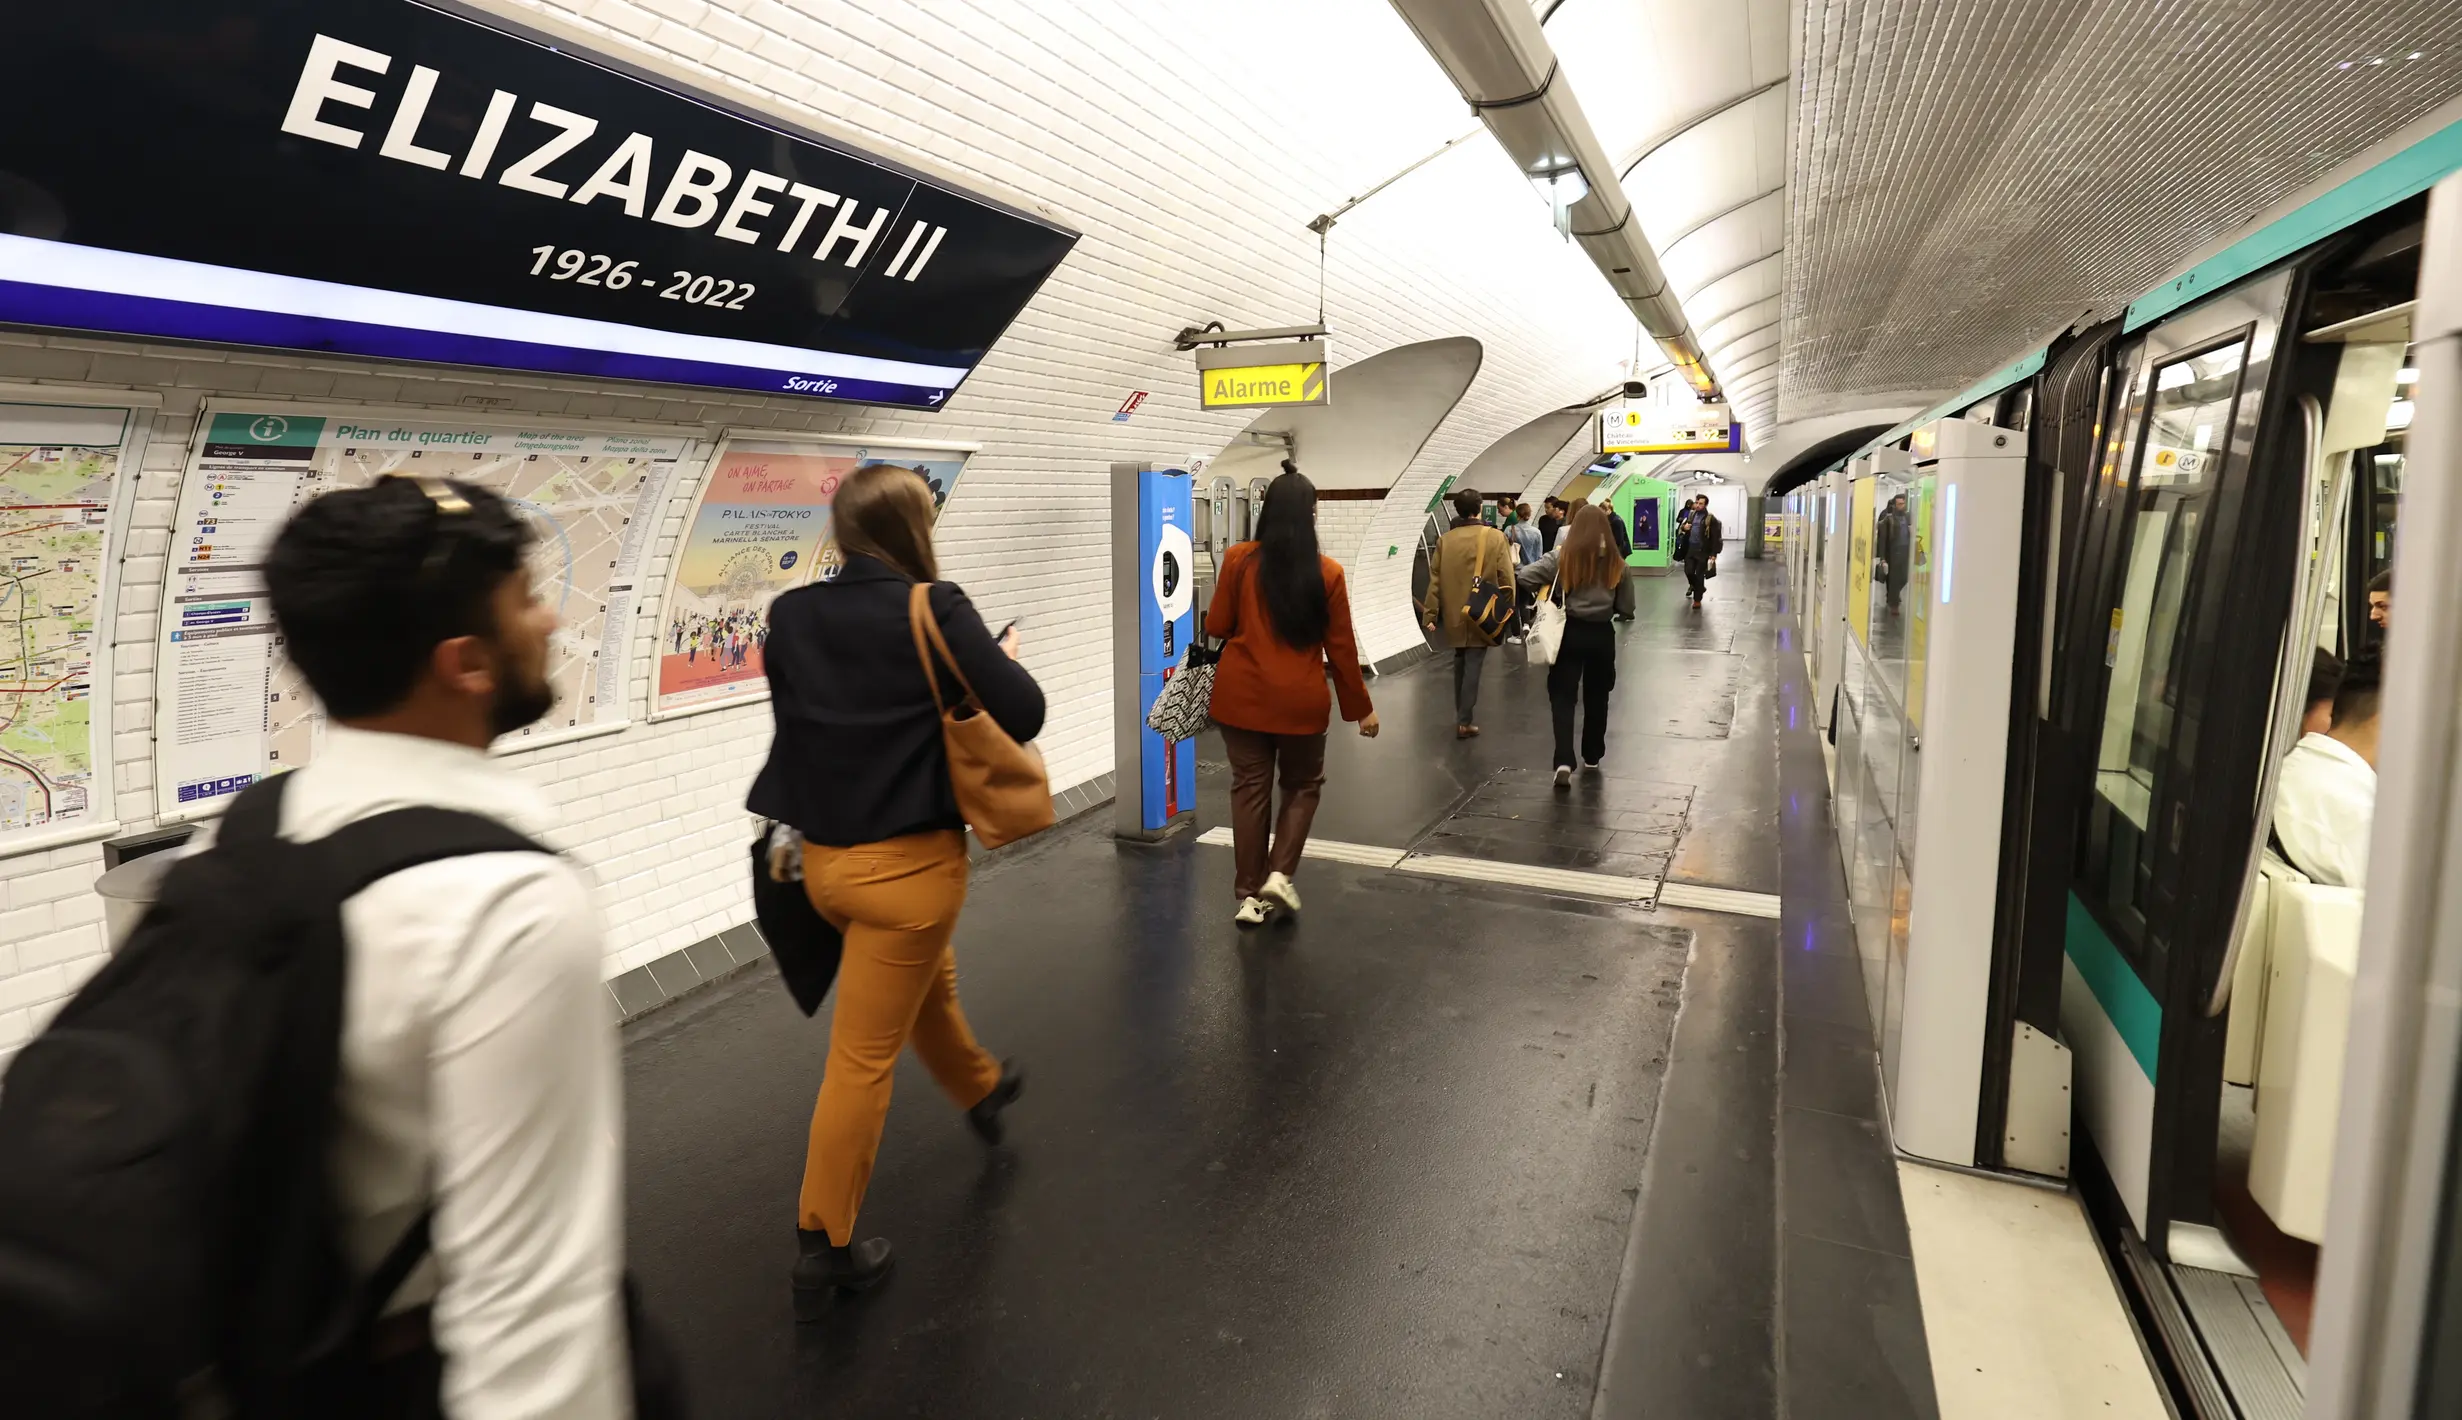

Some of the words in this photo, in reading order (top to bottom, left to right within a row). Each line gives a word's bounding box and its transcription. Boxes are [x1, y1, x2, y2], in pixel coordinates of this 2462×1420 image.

[281, 33, 890, 268] ELIZABETH
[884, 220, 947, 282] II
[529, 245, 639, 290] 1926
[641, 279, 656, 287] -
[659, 270, 755, 310] 2022
[783, 376, 838, 393] Sortie
[1214, 378, 1291, 399] Alarme
[336, 425, 381, 440] Plan
[387, 427, 413, 442] du
[418, 430, 492, 446] quartier
[518, 432, 538, 441] Map
[539, 432, 549, 440] of
[551, 432, 565, 441] the
[606, 436, 628, 444] Plano
[514, 441, 580, 451] Umgebungsplan
[602, 445, 629, 453] Mappa
[728, 467, 740, 478] ON
[742, 464, 769, 479] AIME,
[742, 482, 754, 493] ON
[757, 479, 796, 493] PARTAGE
[722, 509, 768, 519] PALAIS
[771, 510, 811, 519] TOKYO
[712, 536, 758, 544] MARINELLA
[760, 535, 800, 543] SENATORE
[718, 546, 751, 577] ALLIANCE
[752, 545, 767, 554] DES
